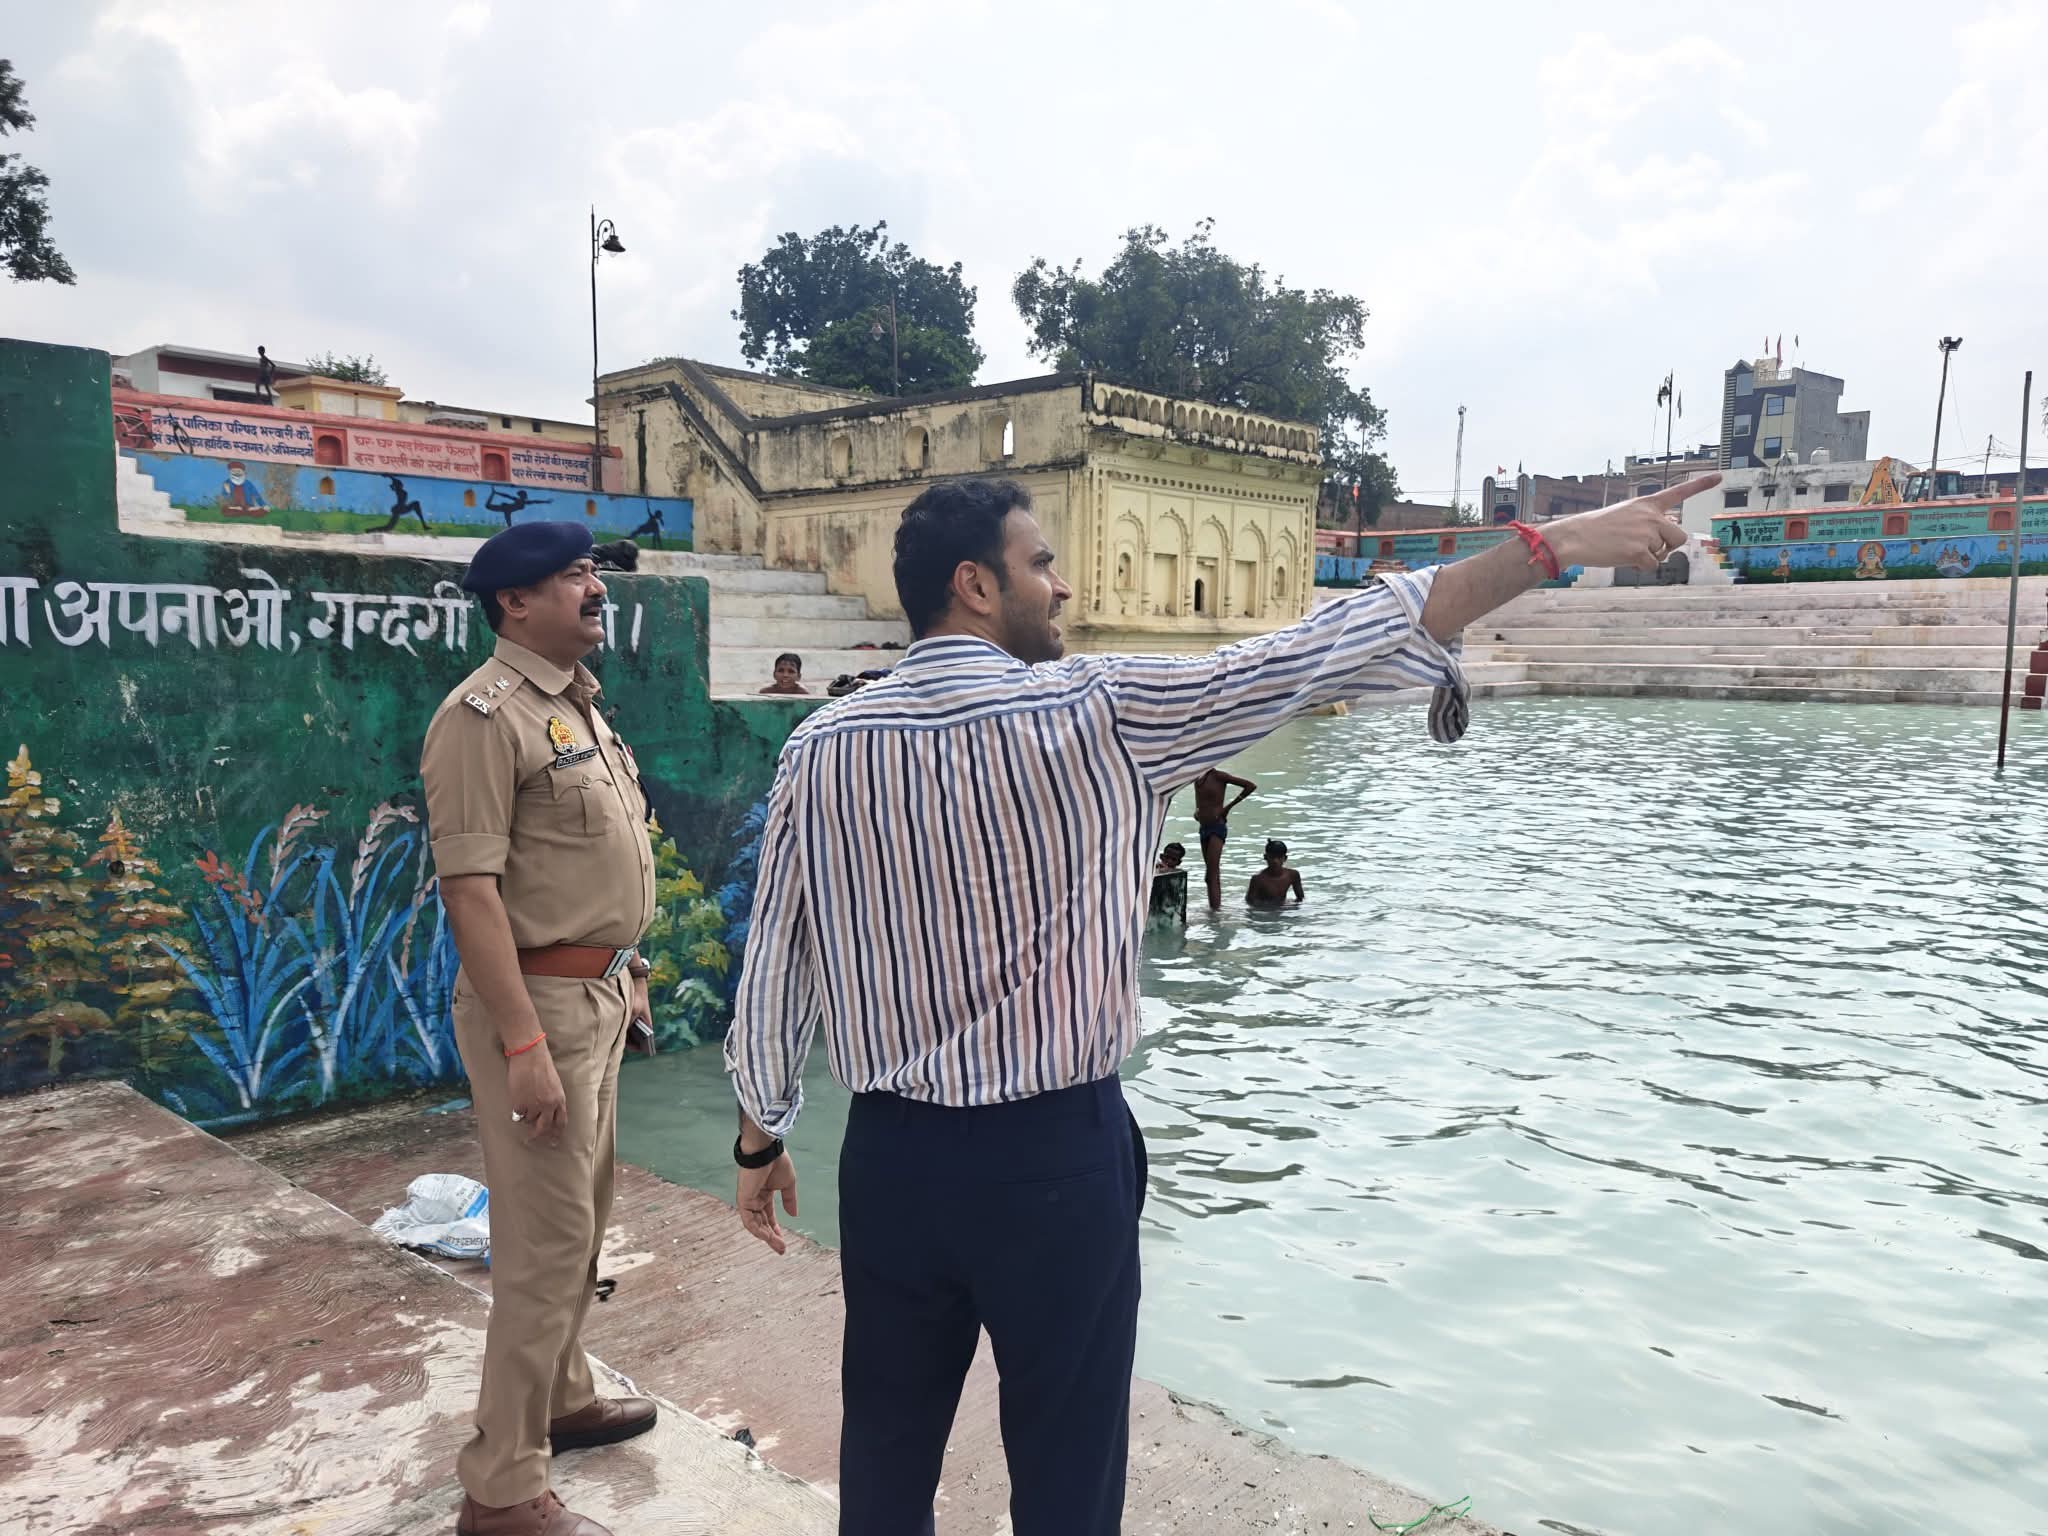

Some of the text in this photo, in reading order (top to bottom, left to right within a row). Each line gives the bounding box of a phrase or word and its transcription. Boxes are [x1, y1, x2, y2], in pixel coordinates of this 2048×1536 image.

[182, 415, 223, 432] पालिका
[225, 420, 257, 437] परिषद
[45, 568, 300, 656] अपनाओ,
[308, 580, 475, 657] गन्दगी
